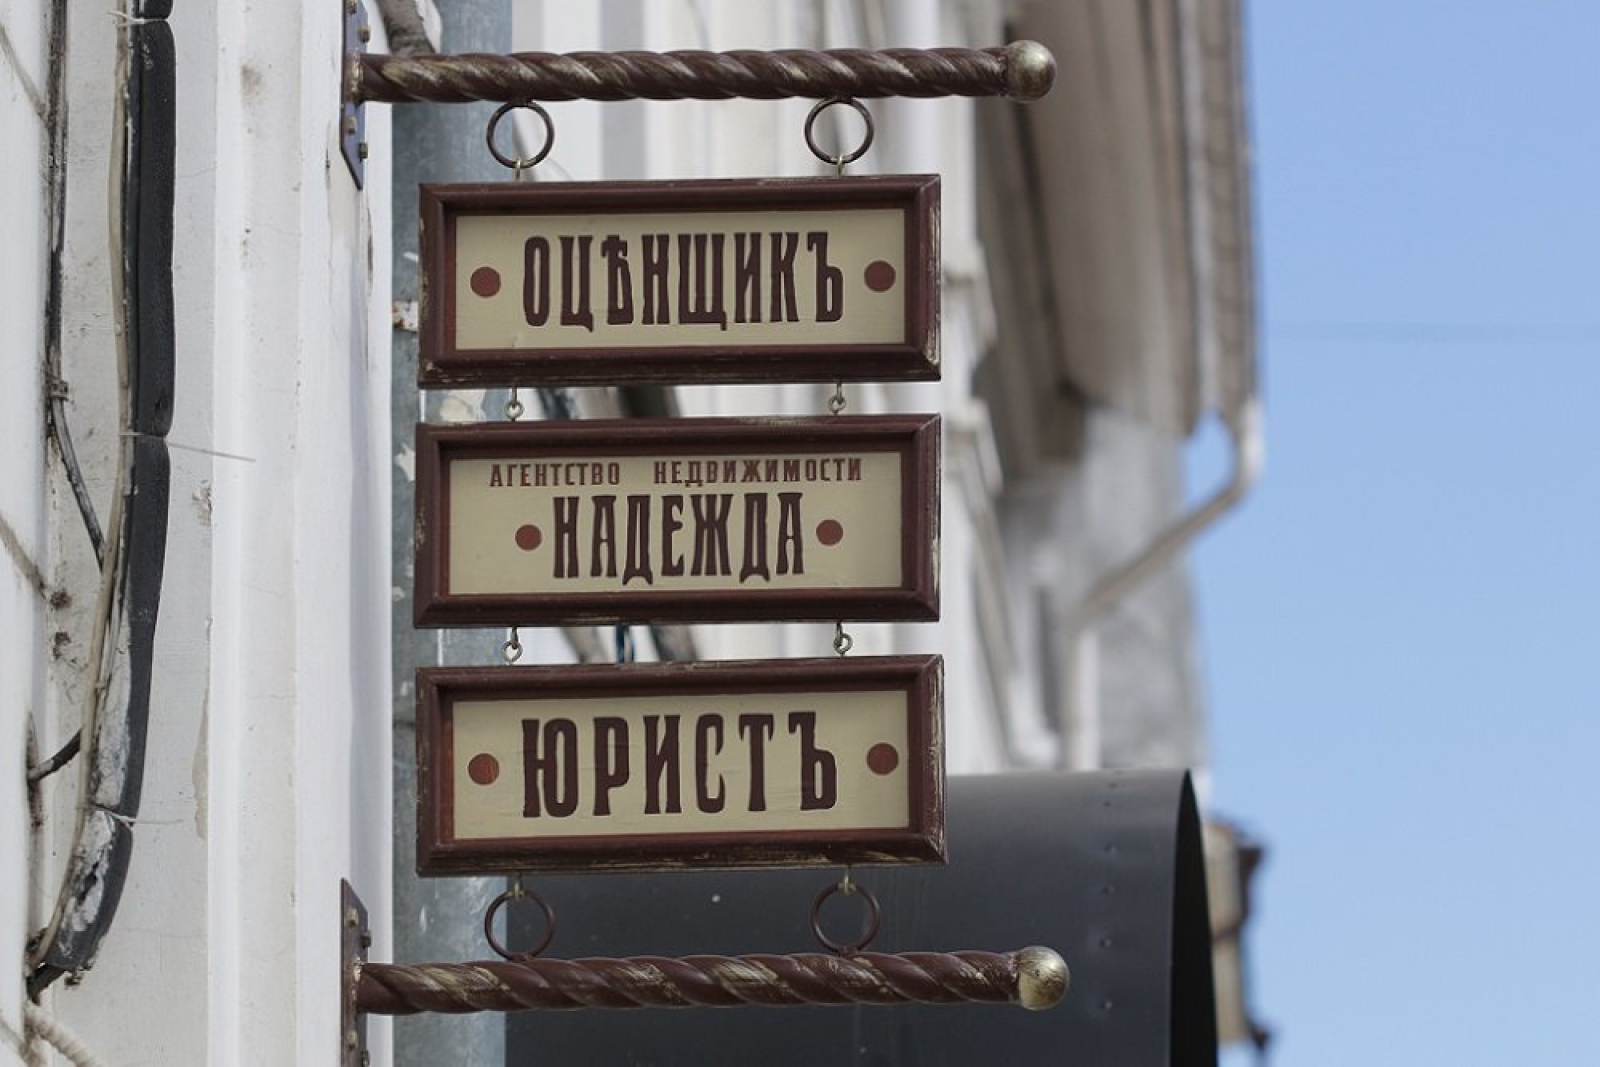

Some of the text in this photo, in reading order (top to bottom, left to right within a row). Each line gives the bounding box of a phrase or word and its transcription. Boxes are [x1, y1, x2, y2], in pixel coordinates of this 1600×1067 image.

[489, 457, 863, 489] АГЕНТСТВО НЕДВИЖИМОСТИ
[551, 491, 805, 587] НАДЕЖДА
[520, 710, 839, 819] ЮРИСТЪ
